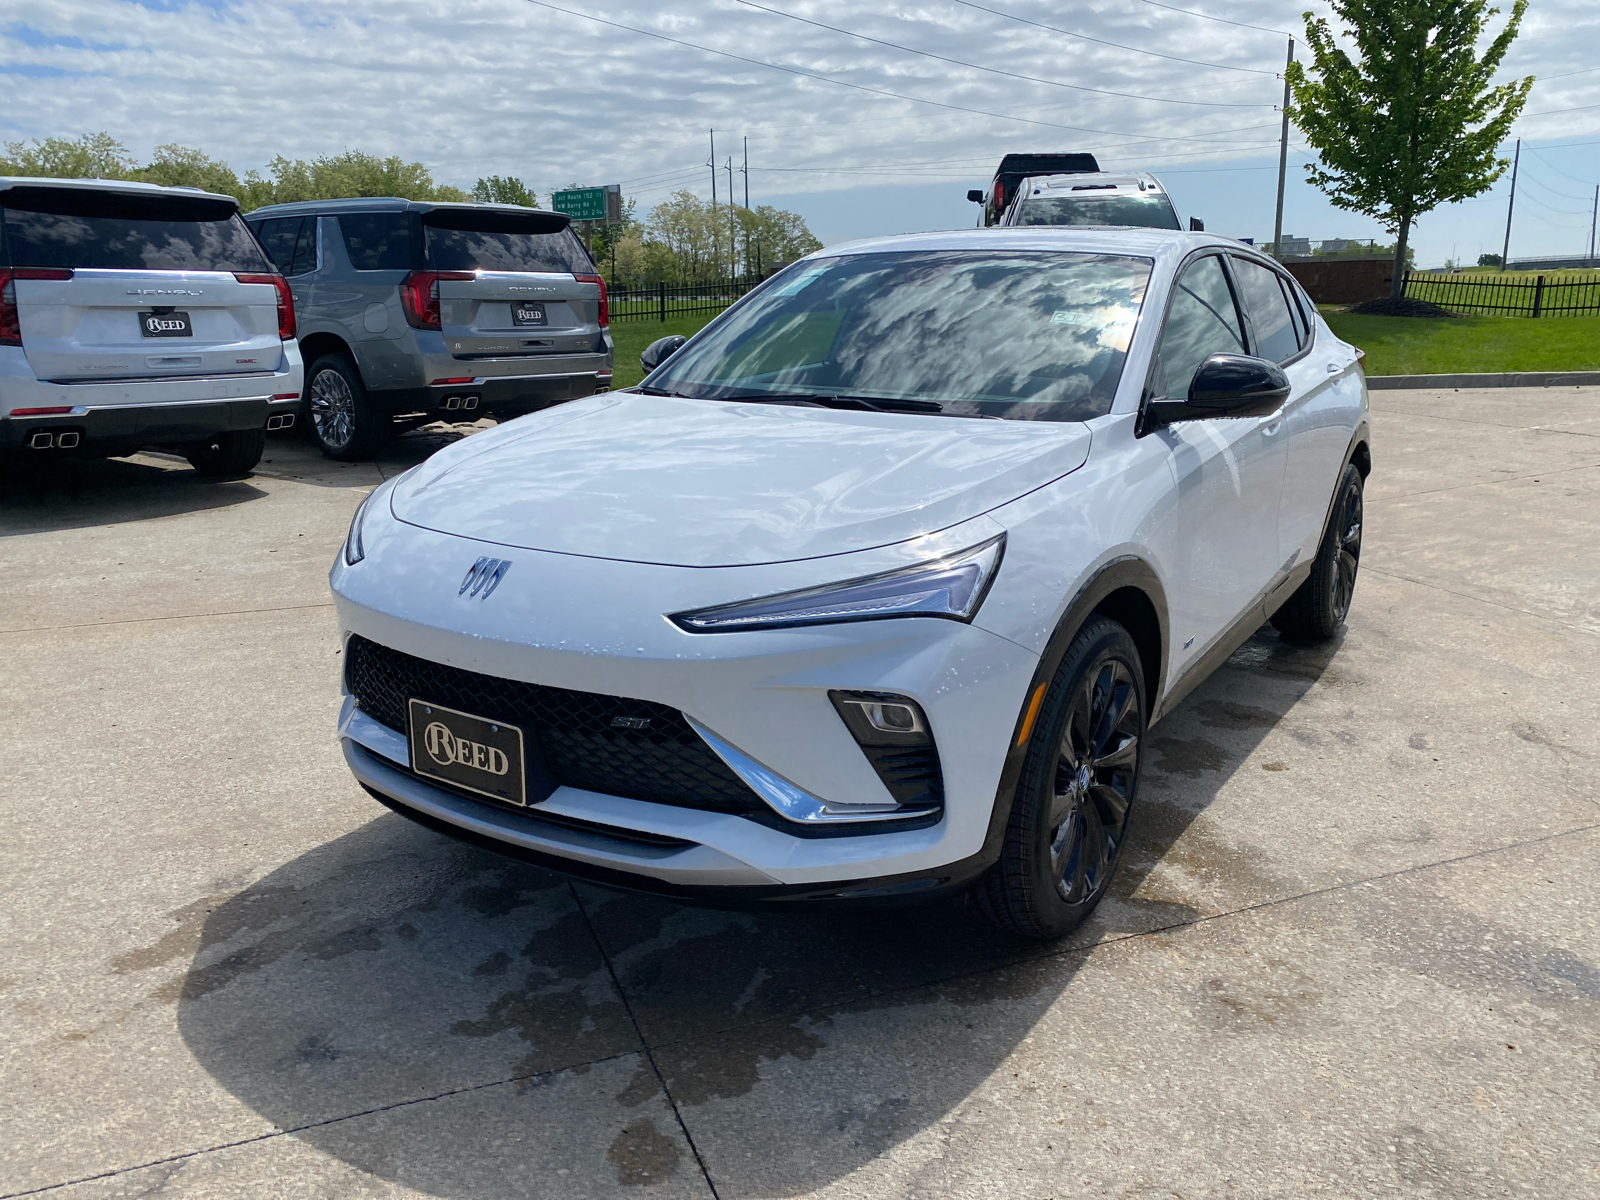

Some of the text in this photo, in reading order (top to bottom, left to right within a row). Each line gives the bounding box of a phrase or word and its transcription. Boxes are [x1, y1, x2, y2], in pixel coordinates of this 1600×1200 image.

[517, 309, 542, 321] REED
[146, 317, 185, 332] REED
[610, 716, 650, 729] ST
[424, 722, 509, 776] REED
